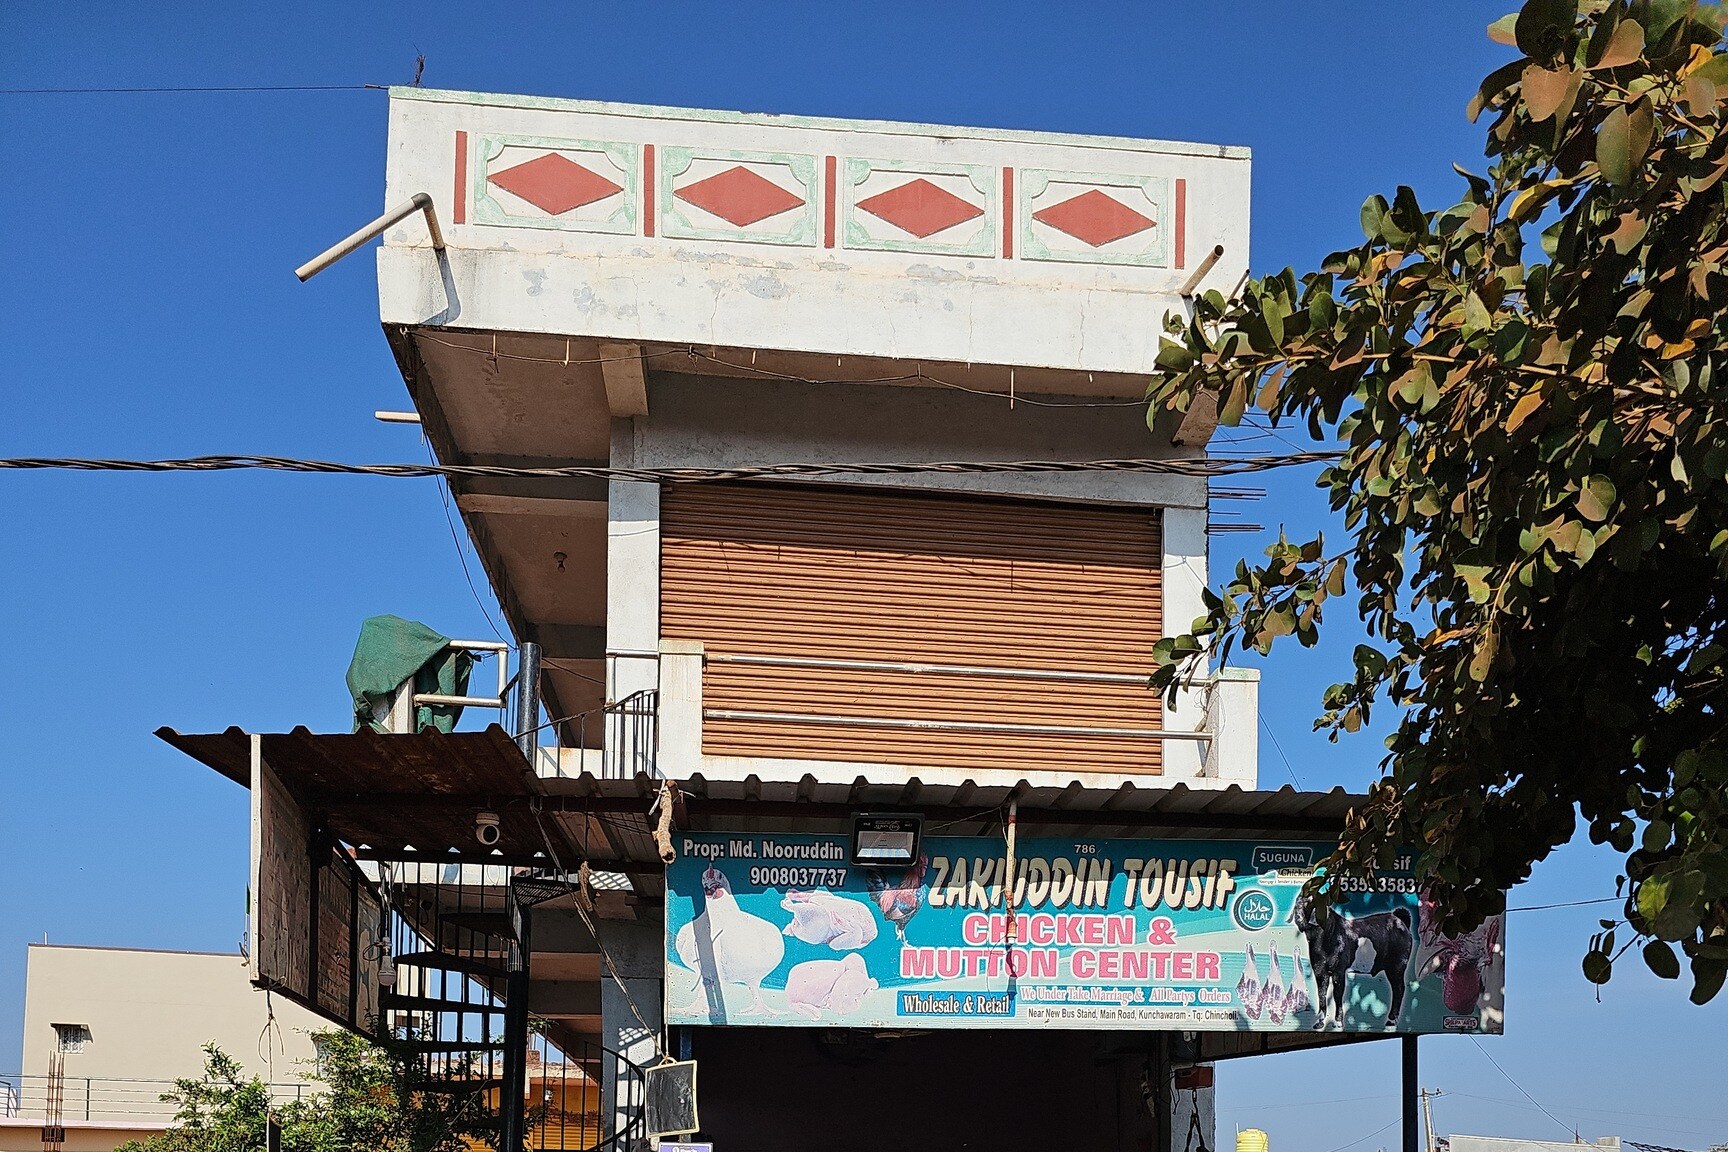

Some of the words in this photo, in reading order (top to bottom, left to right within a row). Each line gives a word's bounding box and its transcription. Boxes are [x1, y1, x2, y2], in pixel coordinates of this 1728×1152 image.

[683, 839, 724, 861] Prop:
[729, 840, 757, 858] Md.
[762, 841, 844, 860] Nooruddin
[1074, 844, 1096, 854] 786
[1260, 852, 1306, 864] SUGUNA
[751, 867, 847, 886] 9008037737
[1281, 868, 1313, 877] Chicken
[928, 857, 1111, 910] ZAKIUDDIN
[1123, 858, 1237, 909] TOUSIF
[1244, 913, 1270, 921] HALAL
[965, 915, 1133, 944] CHICKEN
[1148, 918, 1176, 945] &
[902, 949, 1057, 977] MUTTON
[1072, 950, 1220, 979] CENTER
[903, 995, 959, 1013] Wholesale
[963, 995, 974, 1013] &
[977, 995, 1010, 1014] Retail
[1021, 986, 1036, 1000] We
[1037, 986, 1067, 1000] Under
[1069, 988, 1089, 1001] Take
[1090, 988, 1134, 1005] Marriage
[1135, 989, 1144, 1001] &
[1151, 989, 1167, 1001] All
[1167, 989, 1194, 1006] Partys
[1200, 989, 1230, 1002] Orders
[1028, 1008, 1044, 1018] Near
[1046, 1009, 1060, 1018] New
[1061, 1009, 1075, 1019] Bus
[1077, 1009, 1097, 1020] Stand,
[1100, 1010, 1116, 1019] Main
[1118, 1010, 1136, 1021] Road,
[1138, 1010, 1186, 1020] Kunchawaram
[1192, 1010, 1203, 1021] Tq:
[1205, 1010, 1239, 1021] Chincholi.
